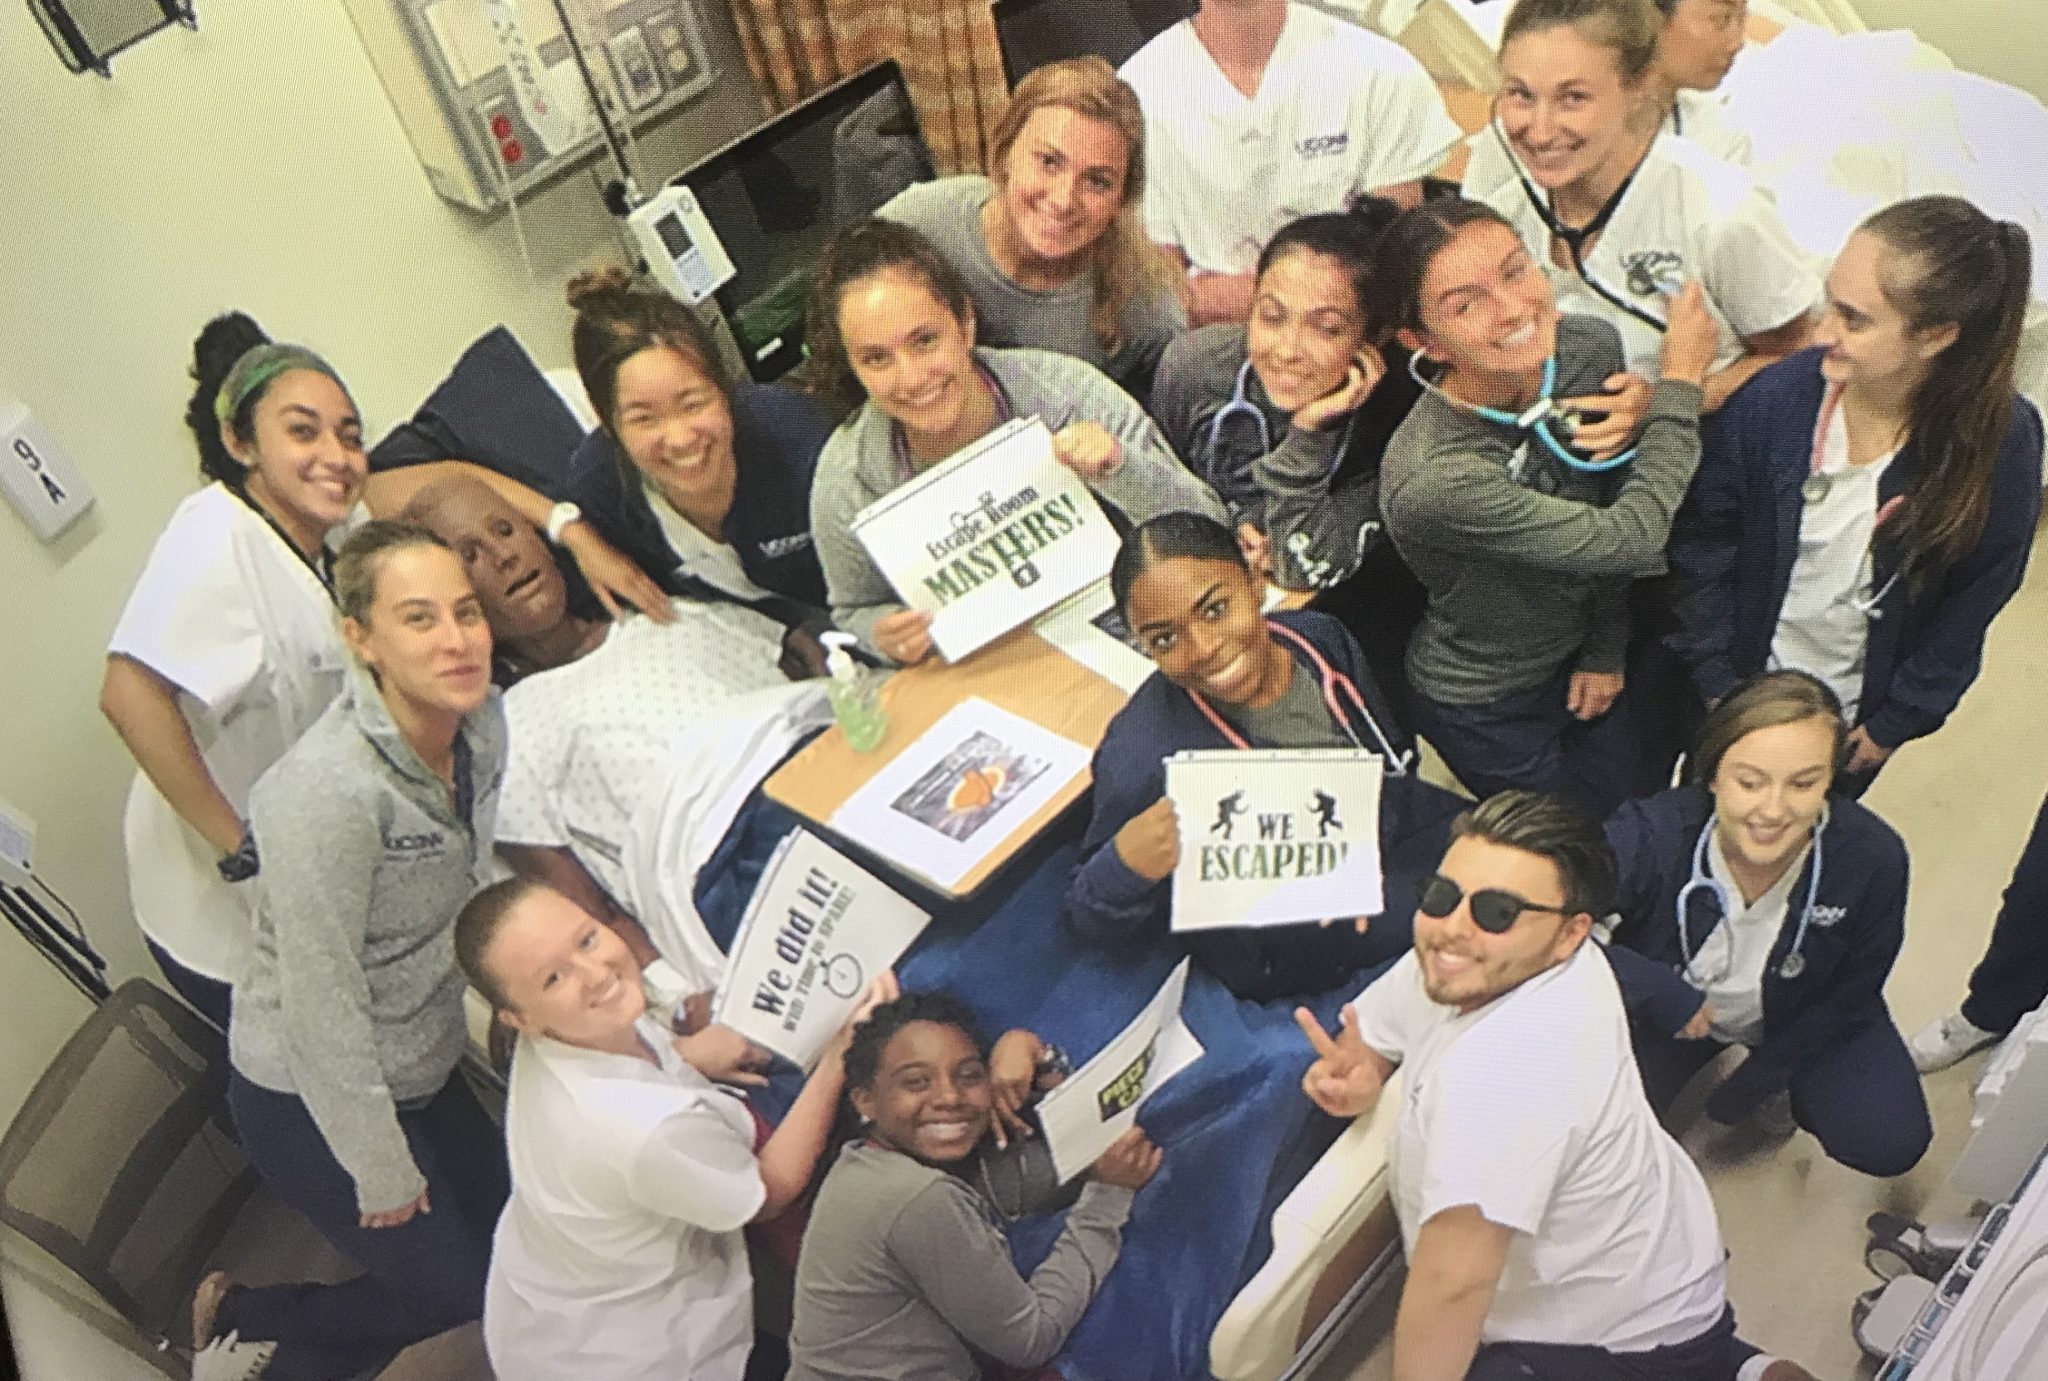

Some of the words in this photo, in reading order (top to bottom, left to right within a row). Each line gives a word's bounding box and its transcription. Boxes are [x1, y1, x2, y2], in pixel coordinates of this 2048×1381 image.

[922, 493, 1085, 607] MASTERS!
[1257, 812, 1295, 841] WE
[752, 968, 793, 1016] We
[775, 906, 816, 965] did
[798, 866, 838, 909] it!
